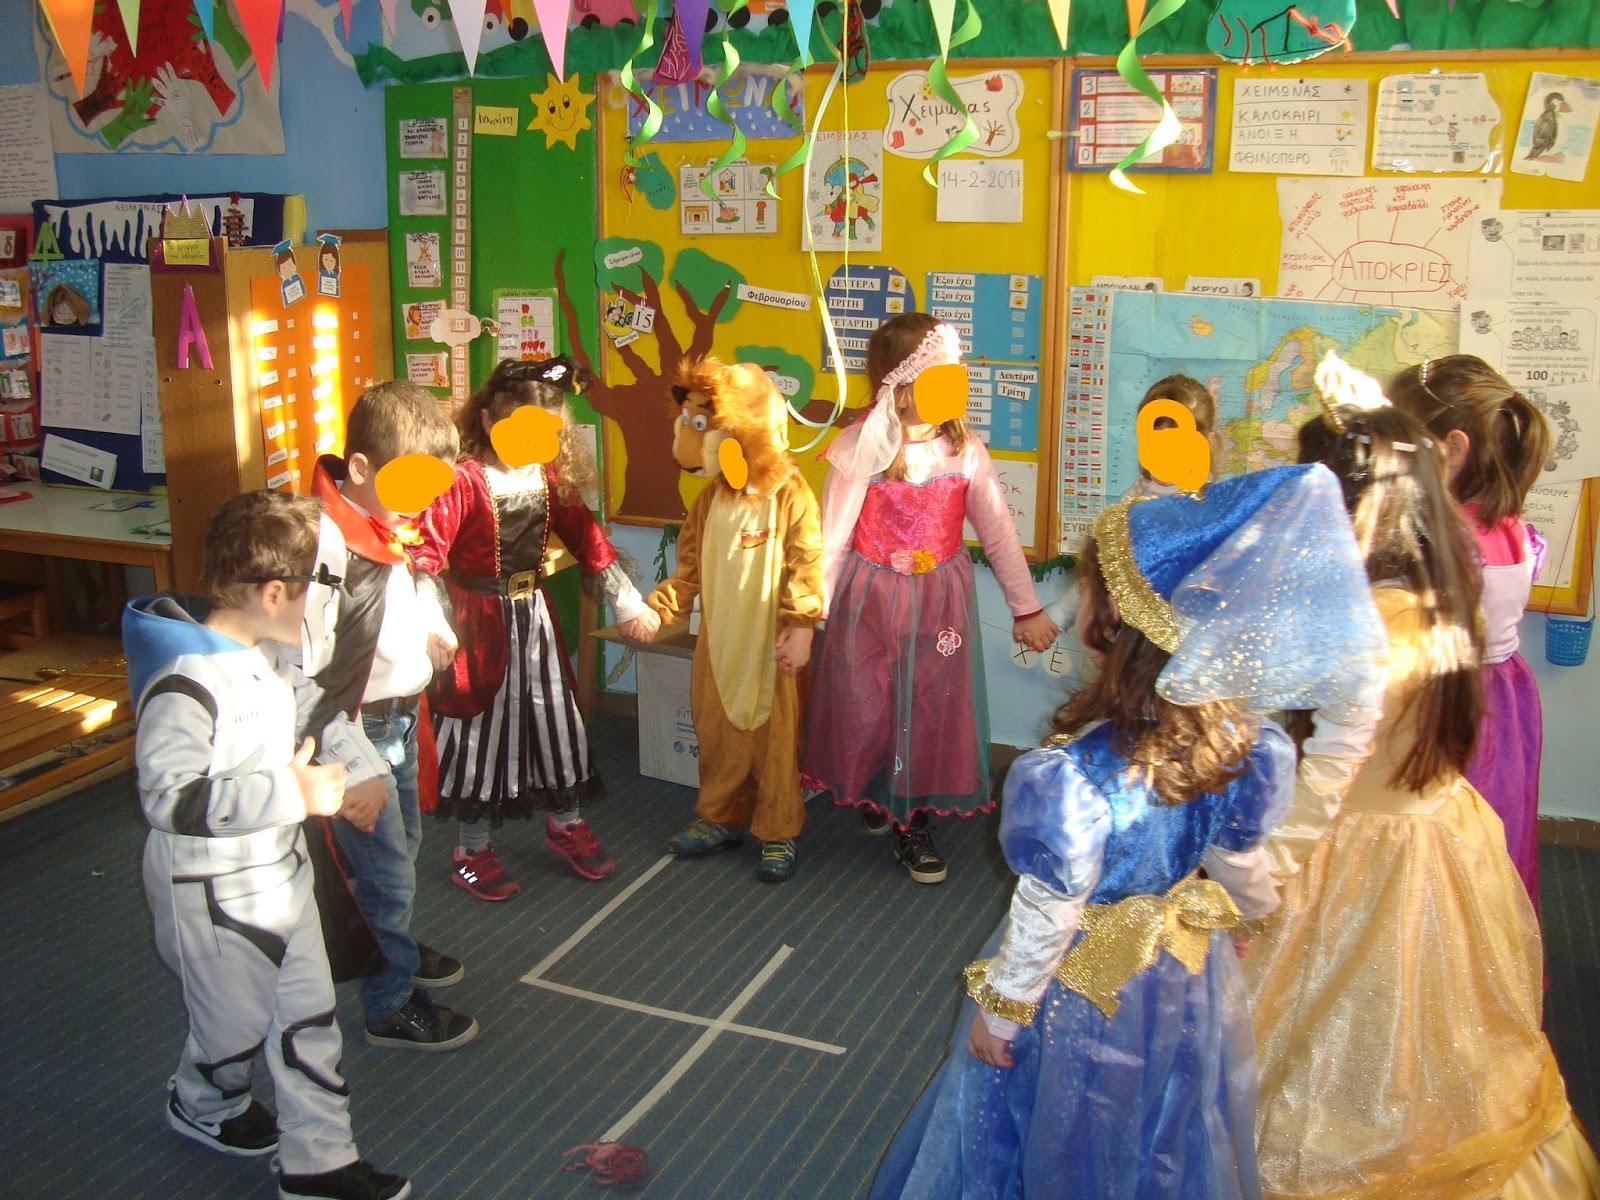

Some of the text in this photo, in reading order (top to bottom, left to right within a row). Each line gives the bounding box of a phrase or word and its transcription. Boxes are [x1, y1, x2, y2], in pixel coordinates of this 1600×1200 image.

[1084, 78, 1094, 93] 3
[1242, 85, 1321, 98] ΧΕΙΜΩΝΑΣ
[1083, 102, 1091, 115] 2
[1238, 109, 1320, 124] ΚΑΛΟΚΑΙΡΙ
[807, 131, 869, 142] ΕΙΜΩΝΑΣ
[1084, 128, 1090, 141] 1
[1238, 128, 1298, 139] ΑΝΟΙΞΗ
[1082, 148, 1090, 161] 0
[1234, 151, 1310, 164] ΦΘΙΝΟΠΩΡΟ
[458, 177, 464, 185] 5
[941, 170, 1020, 189] 14-2-2017
[458, 220, 464, 228] 8
[608, 254, 628, 265] Σήμερα
[456, 264, 464, 272] 11
[1339, 250, 1452, 284] ΑΠΟΚΡΙΕΣ
[456, 278, 464, 286] 12
[831, 279, 874, 288] ΔΕΥΤΕΡΑ
[933, 276, 972, 287] Έξω έχει
[1192, 286, 1229, 294] ΚΡΥΟ
[747, 290, 806, 308] Φεβρουαρίου
[933, 291, 972, 303] Έξω έχει
[830, 298, 859, 308] ΤΡΙΤΗ
[932, 308, 970, 320] Έξω έχει
[635, 312, 652, 328] 15
[831, 318, 873, 328] ΤΕΤΑΡΤΗ
[617, 333, 638, 346] Δευτέρα
[836, 339, 869, 348] ΕΜΠΤ
[456, 362, 464, 370] 18
[828, 358, 866, 368] ΠΡΑΣΚ
[456, 376, 464, 384] 19
[999, 372, 1034, 380] Δευτέρα
[1526, 370, 1548, 380] 100
[1001, 386, 1026, 399] Τρίτη
